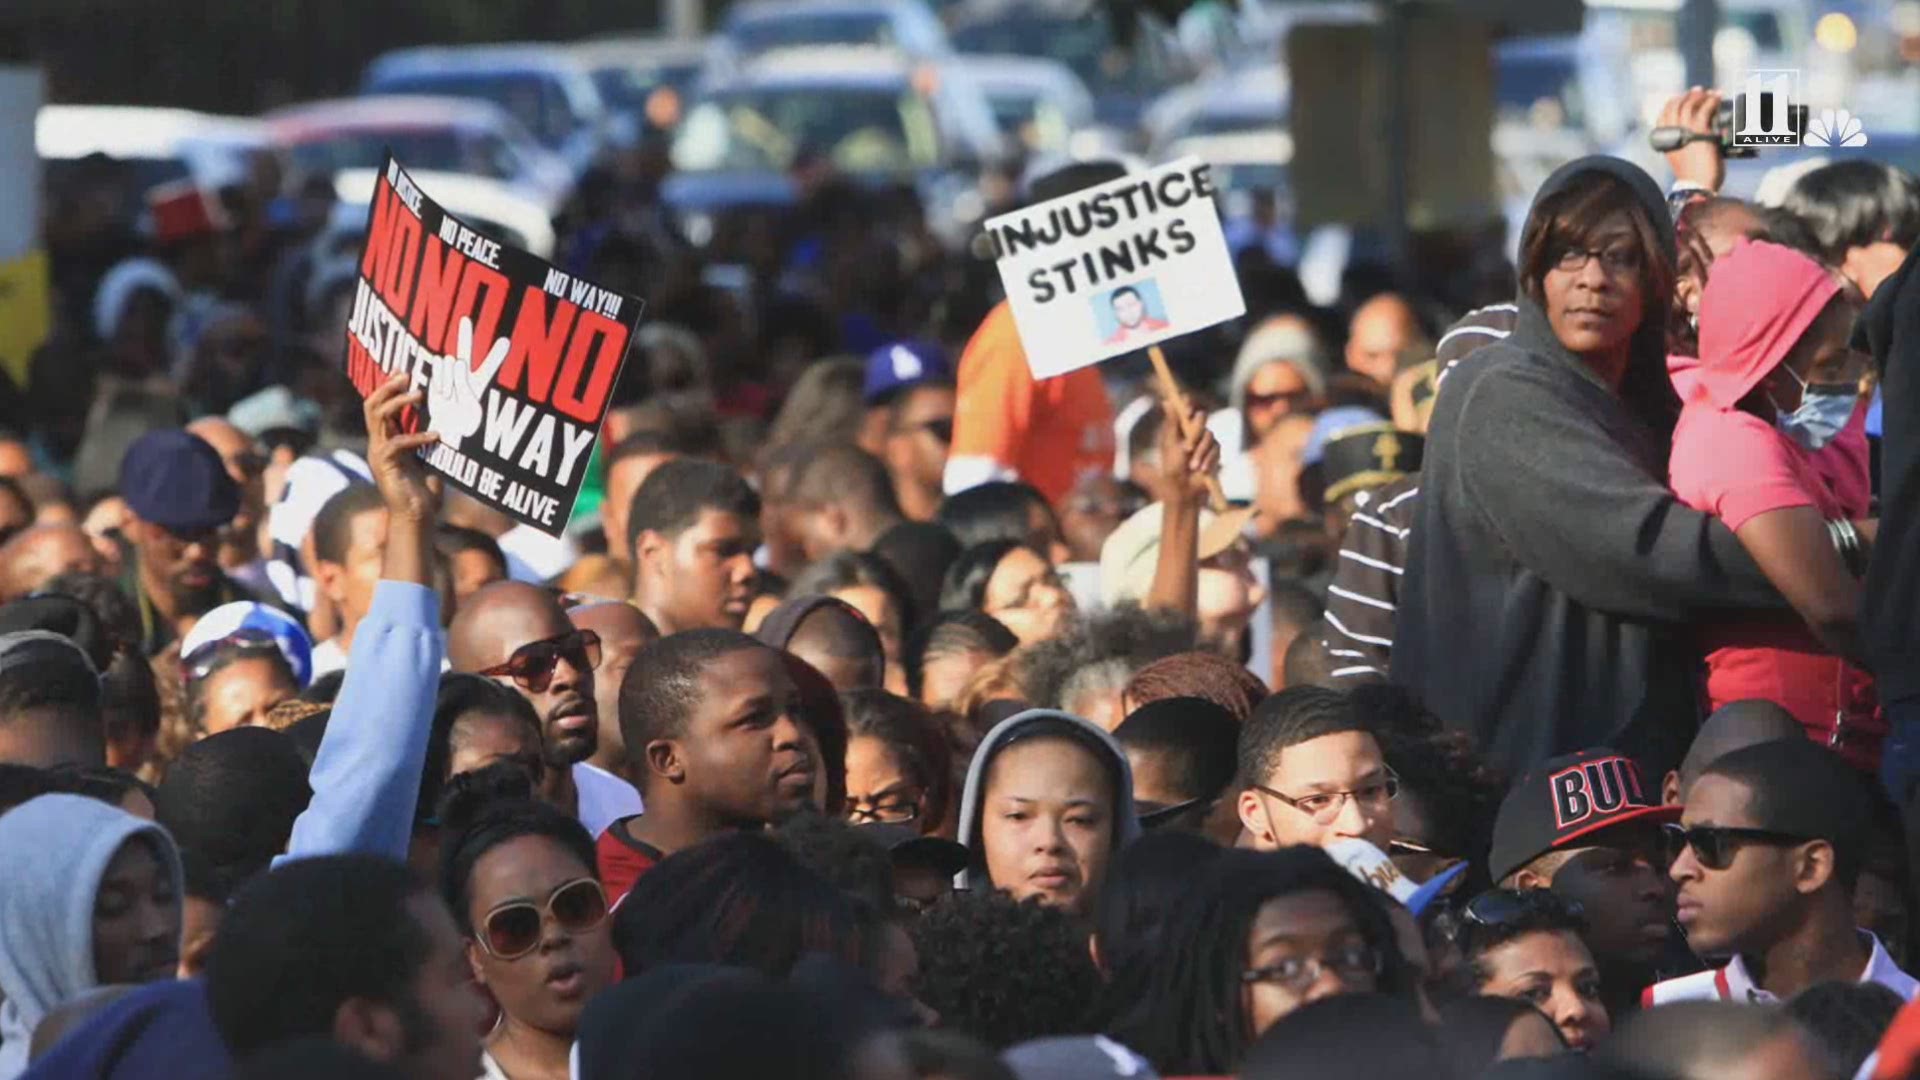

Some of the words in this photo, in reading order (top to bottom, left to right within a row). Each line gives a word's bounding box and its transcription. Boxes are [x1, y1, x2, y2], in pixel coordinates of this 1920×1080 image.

[439, 214, 458, 246] NO
[990, 164, 1219, 259] INJUSTICE
[362, 175, 423, 318] NO
[409, 233, 511, 373] NO
[497, 285, 629, 424] NO
[544, 268, 571, 298] NO
[571, 278, 623, 321] WAY!!!
[1028, 218, 1196, 304] STINKS
[481, 388, 594, 488] WAY
[477, 467, 505, 500] BE
[501, 485, 560, 527] ALIVE
